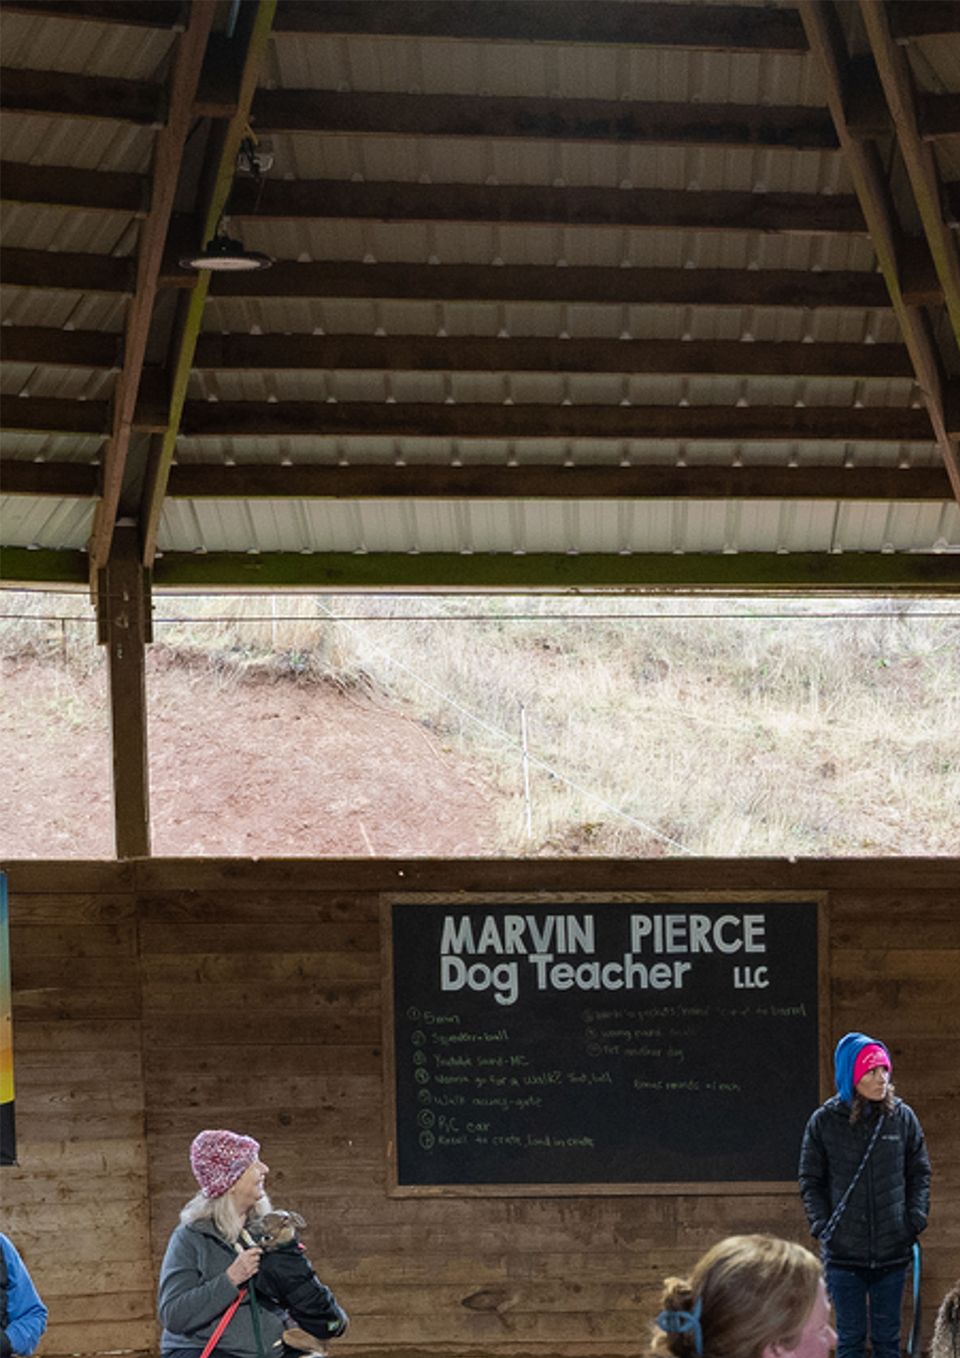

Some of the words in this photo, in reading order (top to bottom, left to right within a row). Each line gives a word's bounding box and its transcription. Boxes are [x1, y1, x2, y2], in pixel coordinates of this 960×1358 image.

[439, 915, 594, 954] MARVIN
[630, 914, 765, 953] PIERCE
[440, 955, 518, 1005] Dog
[528, 953, 692, 990] Teacher
[733, 966, 770, 988] LLC
